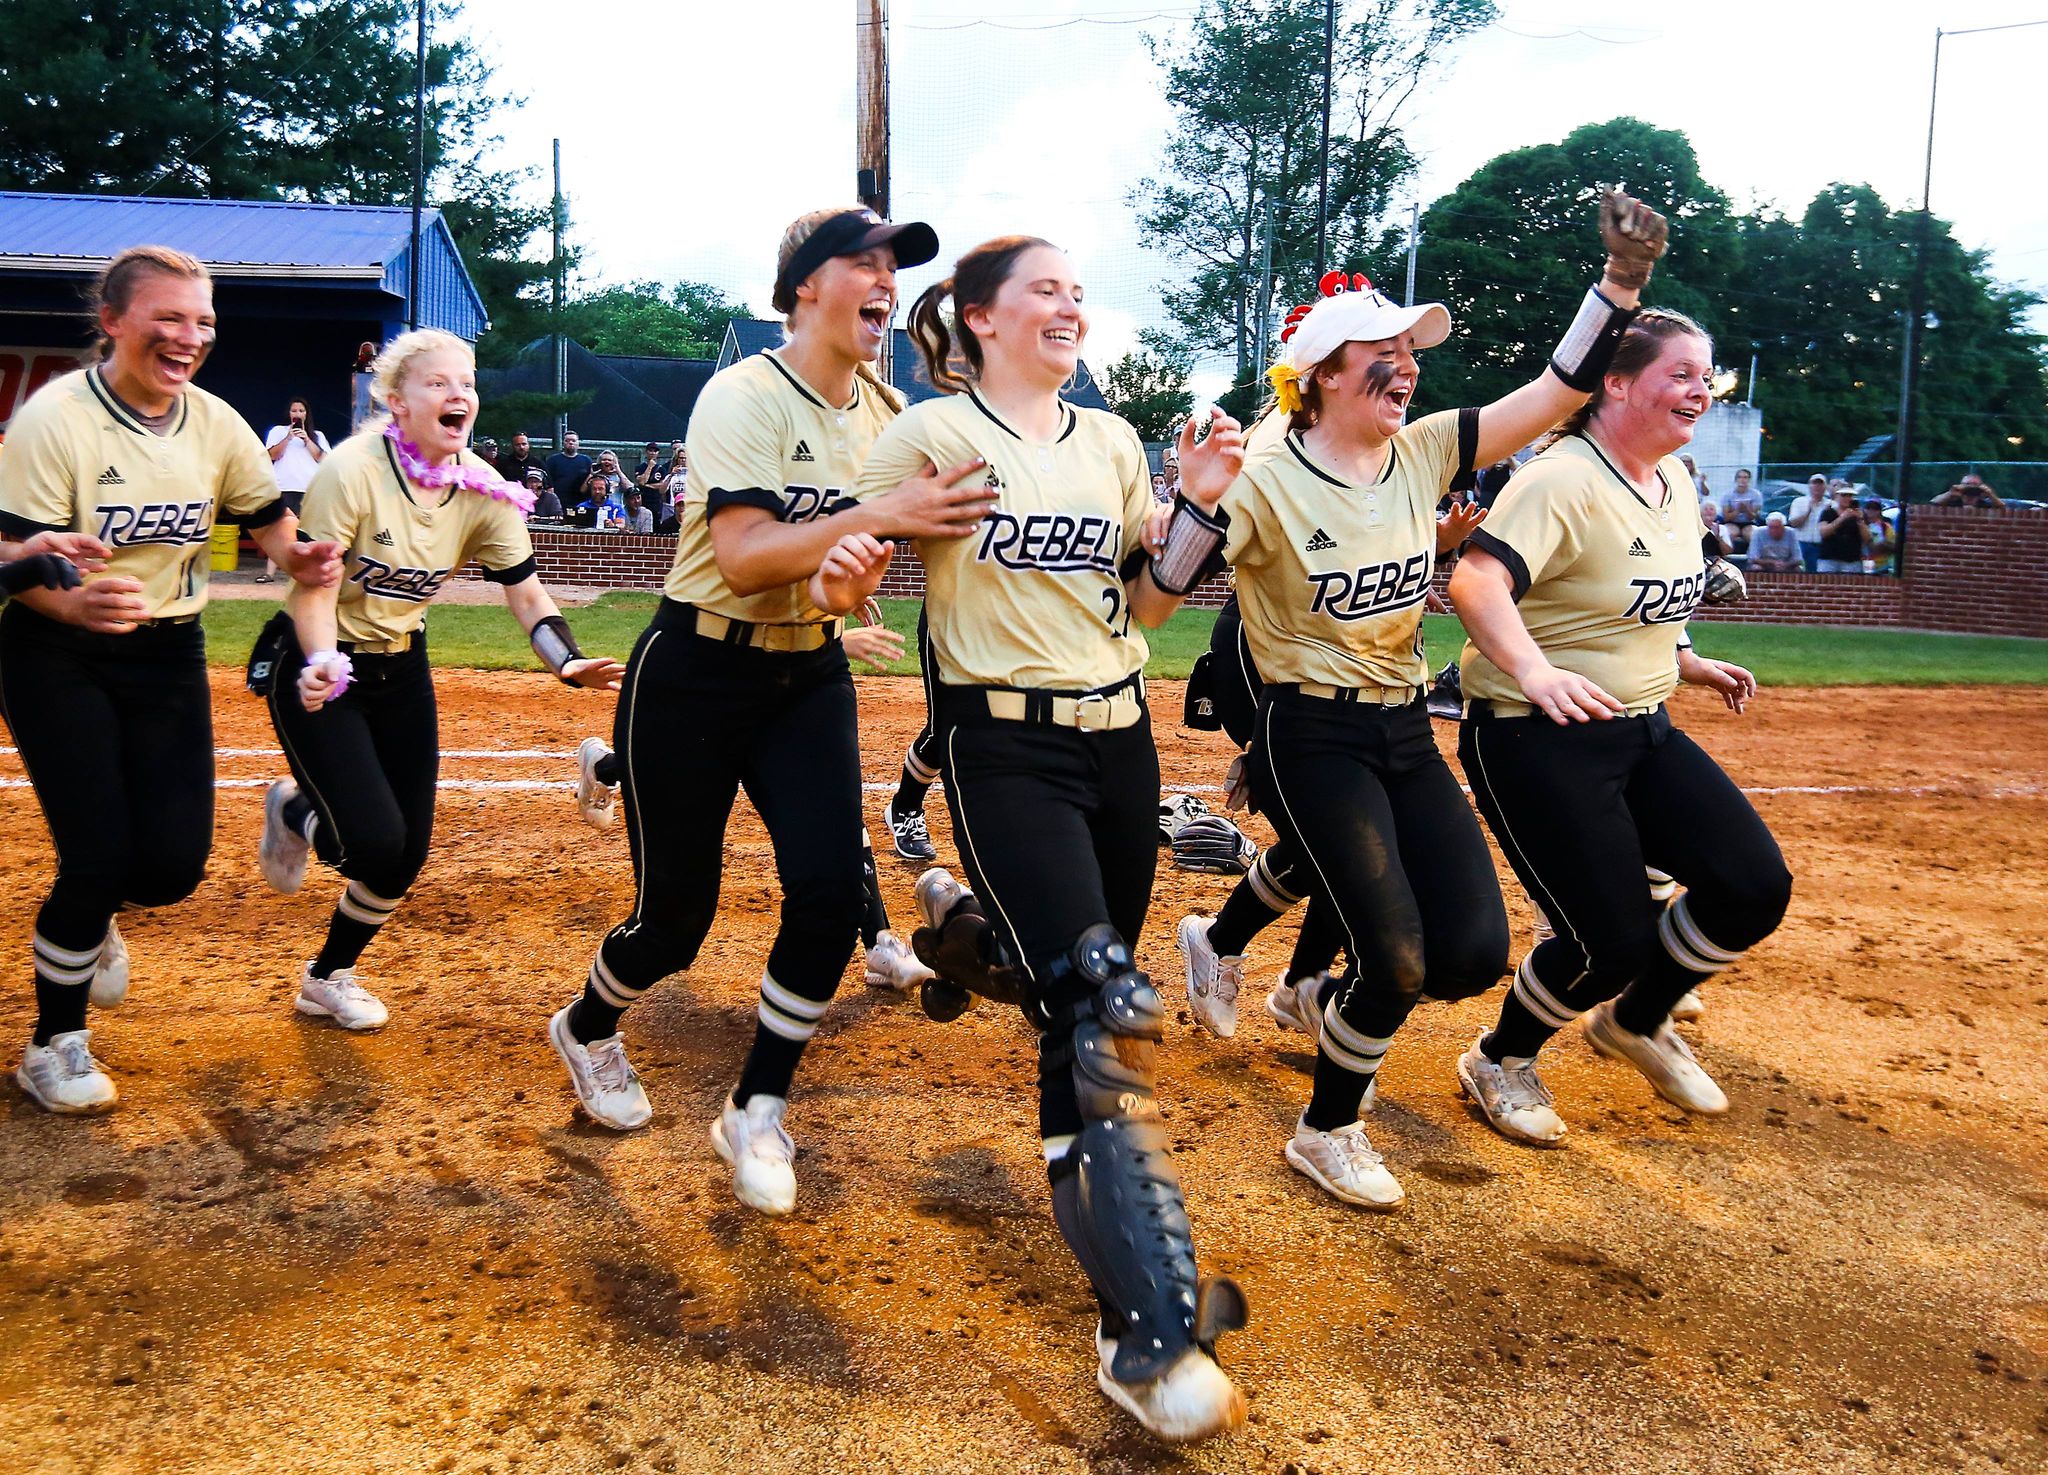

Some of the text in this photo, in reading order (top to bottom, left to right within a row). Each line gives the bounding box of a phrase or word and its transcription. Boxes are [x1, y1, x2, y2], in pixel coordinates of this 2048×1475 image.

[95, 497, 214, 548] REBEL
[977, 512, 1121, 578] REBEL
[1305, 539, 1338, 552] adidas
[349, 555, 453, 603] REBE
[1307, 549, 1432, 621] REBEL
[1622, 572, 1704, 625] REBE
